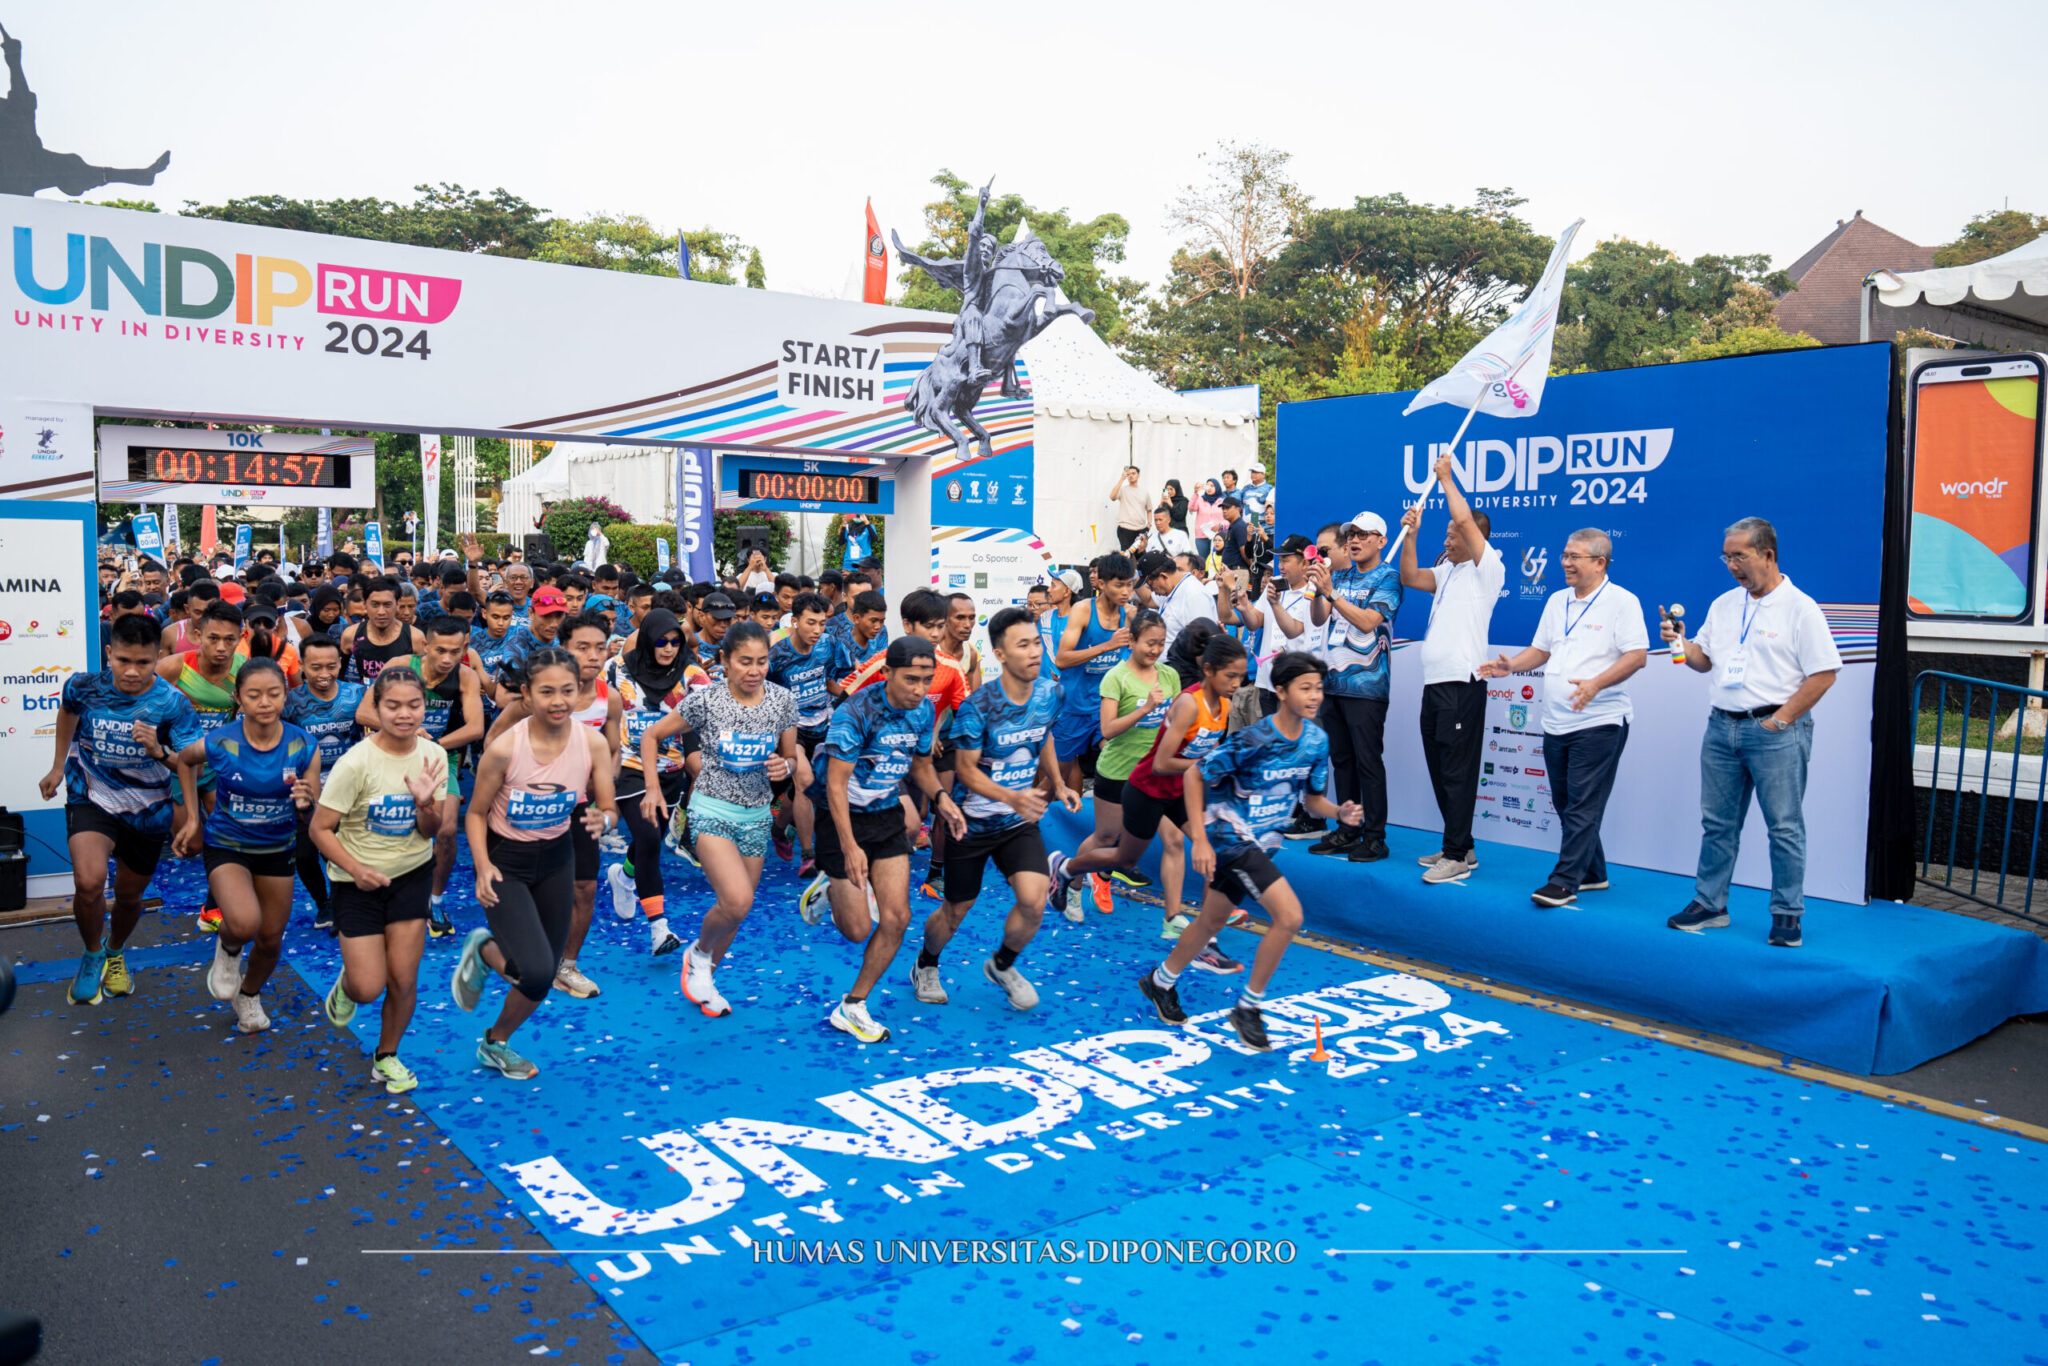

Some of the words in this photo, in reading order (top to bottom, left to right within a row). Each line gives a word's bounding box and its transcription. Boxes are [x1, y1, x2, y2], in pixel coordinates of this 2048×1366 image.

[13, 226, 313, 326] UNDIP
[325, 270, 429, 317] RUN
[15, 310, 105, 333] UNITY
[122, 320, 147, 337] IN
[165, 324, 304, 351] DIVERSITY
[325, 321, 431, 361] 2024
[782, 340, 880, 370] START/
[789, 372, 874, 401] FINISH
[227, 433, 263, 448] 10K
[156, 450, 325, 486] 00:14:57
[804, 461, 819, 472] 5K
[1404, 436, 1565, 494] UNDIP
[1572, 435, 1647, 469] RUN
[755, 473, 863, 502] 00:00:00
[1570, 476, 1647, 505] 2024
[1941, 477, 2008, 495] wondr
[684, 451, 702, 553] UNDIP
[1475, 495, 1557, 508] DIVERSITY
[972, 554, 983, 562] Co
[986, 554, 1018, 564] Sponsor
[3, 672, 58, 684] mandiri
[1728, 666, 1743, 674] VIP
[23, 694, 60, 711] btn
[92, 718, 133, 733] UNDIP
[305, 722, 337, 734] UNDIP
[998, 730, 1030, 746] UNDIP
[95, 740, 147, 757] G3806
[722, 742, 766, 756] M3271
[511, 802, 565, 815] H3061
[1288, 1011, 1509, 1079] 2024
[504, 1029, 1211, 1236] UNDIP
[596, 1198, 844, 1282] UNITY
[881, 1170, 966, 1204] IN
[985, 1079, 1295, 1174] DIVERSITY
